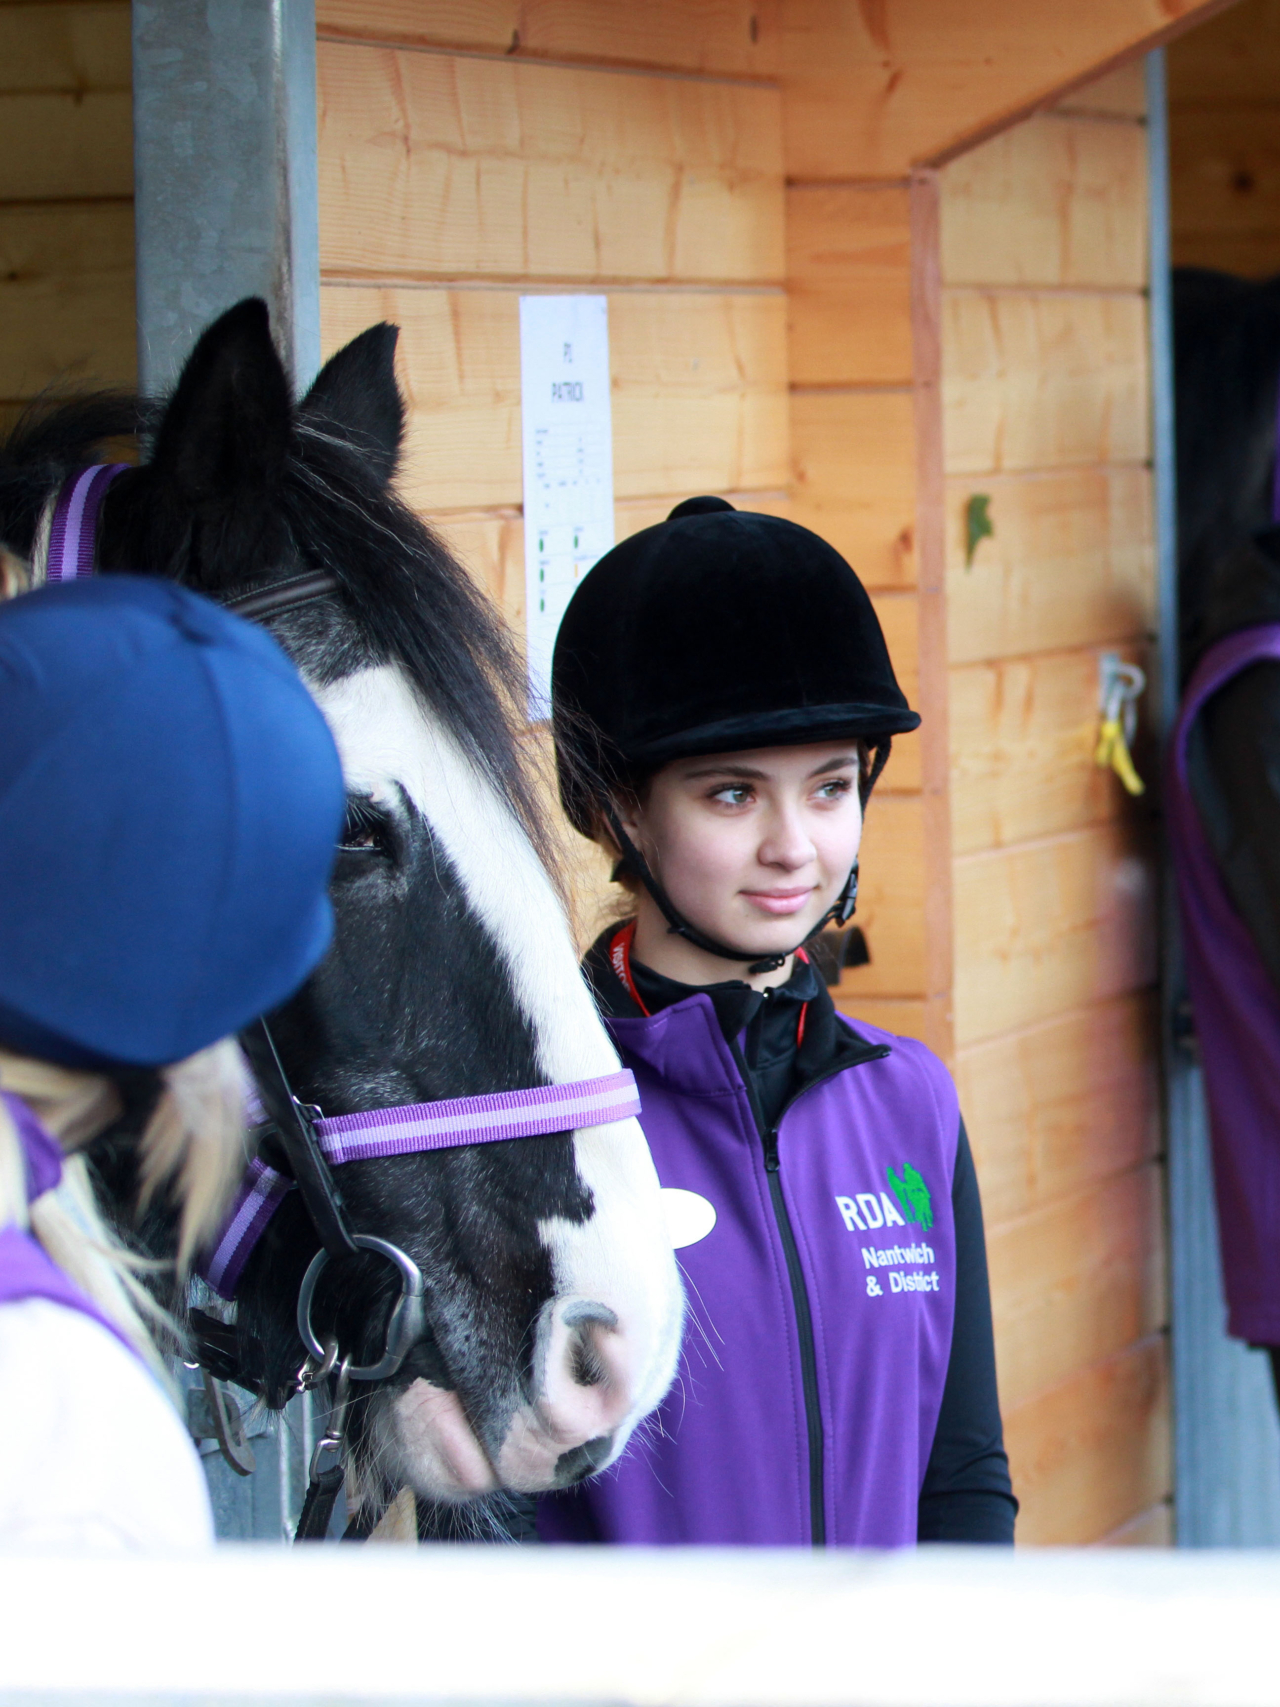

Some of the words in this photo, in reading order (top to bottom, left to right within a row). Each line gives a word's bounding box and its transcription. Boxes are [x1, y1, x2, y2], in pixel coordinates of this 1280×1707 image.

[835, 1192, 905, 1231] RDA
[861, 1242, 935, 1269] Nantwich
[866, 1275, 883, 1297] &
[888, 1271, 940, 1293] District
